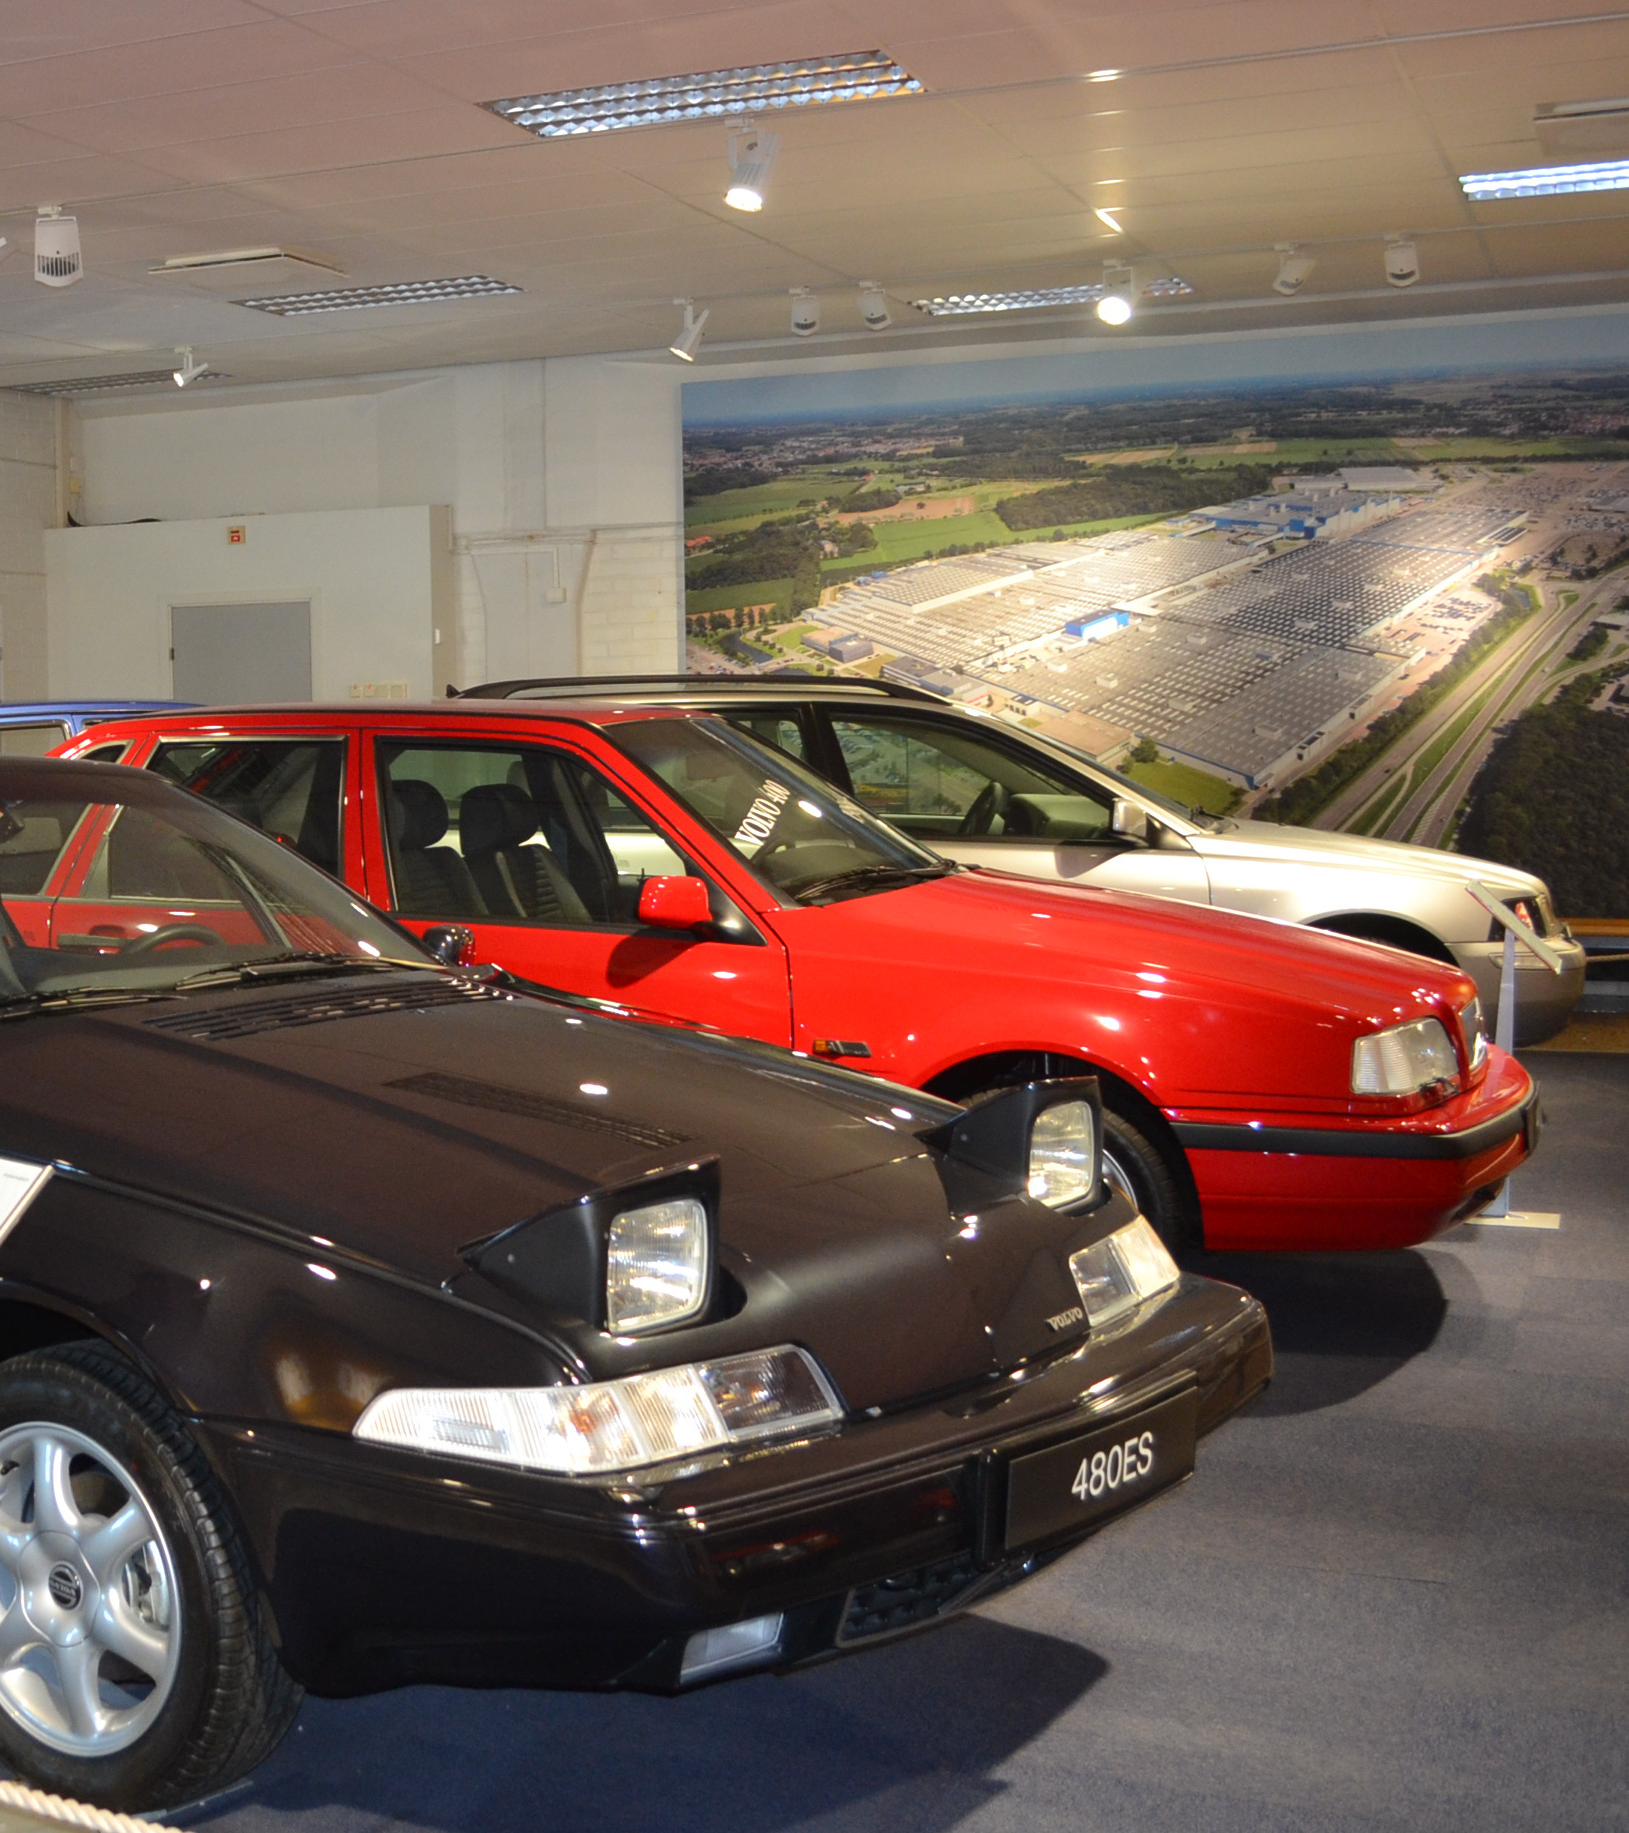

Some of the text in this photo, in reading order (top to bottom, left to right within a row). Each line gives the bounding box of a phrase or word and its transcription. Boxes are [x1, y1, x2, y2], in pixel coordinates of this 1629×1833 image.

[734, 798, 781, 846] VOLVO
[1046, 1306, 1083, 1331] VOLVO
[1071, 1431, 1154, 1500] 480ES
